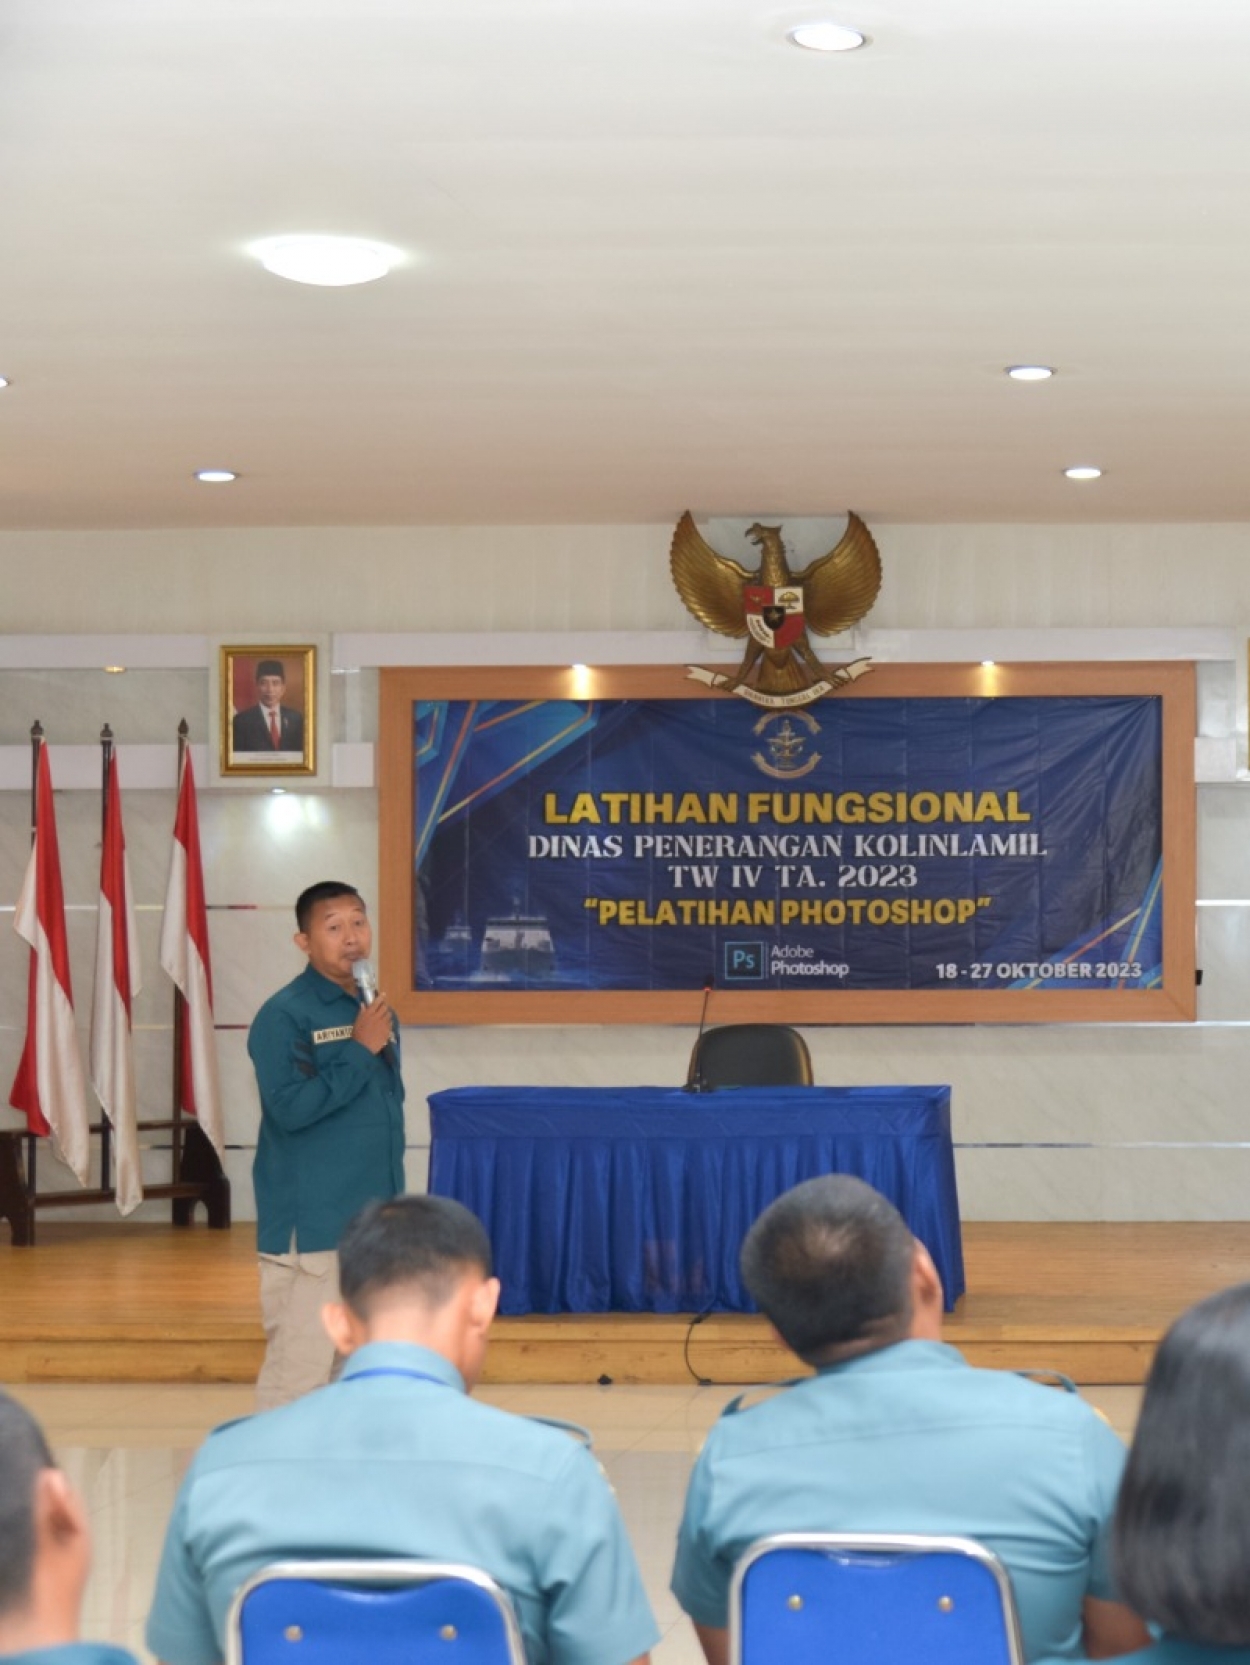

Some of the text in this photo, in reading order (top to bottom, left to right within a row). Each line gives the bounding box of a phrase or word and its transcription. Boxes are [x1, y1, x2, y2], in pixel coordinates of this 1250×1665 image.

[544, 791, 1031, 824] LATIHAN FUNGSIONAL
[528, 833, 1048, 858] DINAS PENERANGAN KOLINLAMIL
[667, 864, 918, 888] TW IV TA. 2023
[733, 950, 756, 969] Ps
[771, 944, 814, 958] Adobe
[771, 960, 850, 978] Photoshop
[936, 963, 957, 979] 18
[970, 963, 993, 979] 27
[996, 962, 1092, 979] OKTOBER
[1095, 962, 1143, 978] 2023
